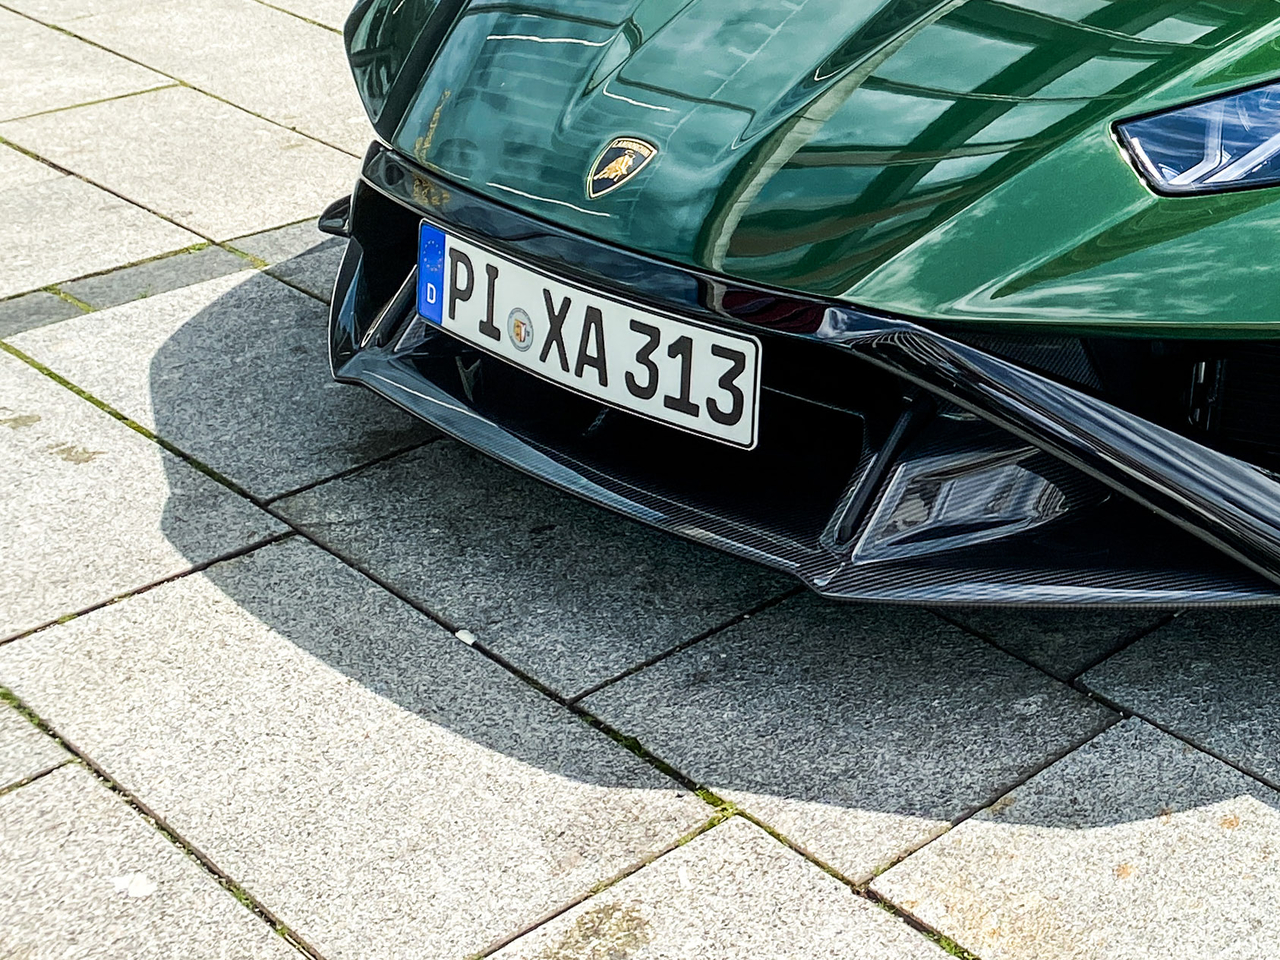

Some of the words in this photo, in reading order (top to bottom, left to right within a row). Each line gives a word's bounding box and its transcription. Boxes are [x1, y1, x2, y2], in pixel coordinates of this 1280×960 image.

[426, 282, 437, 305] D
[447, 247, 502, 342] PI
[539, 288, 608, 388] XA
[624, 318, 745, 426] 313
